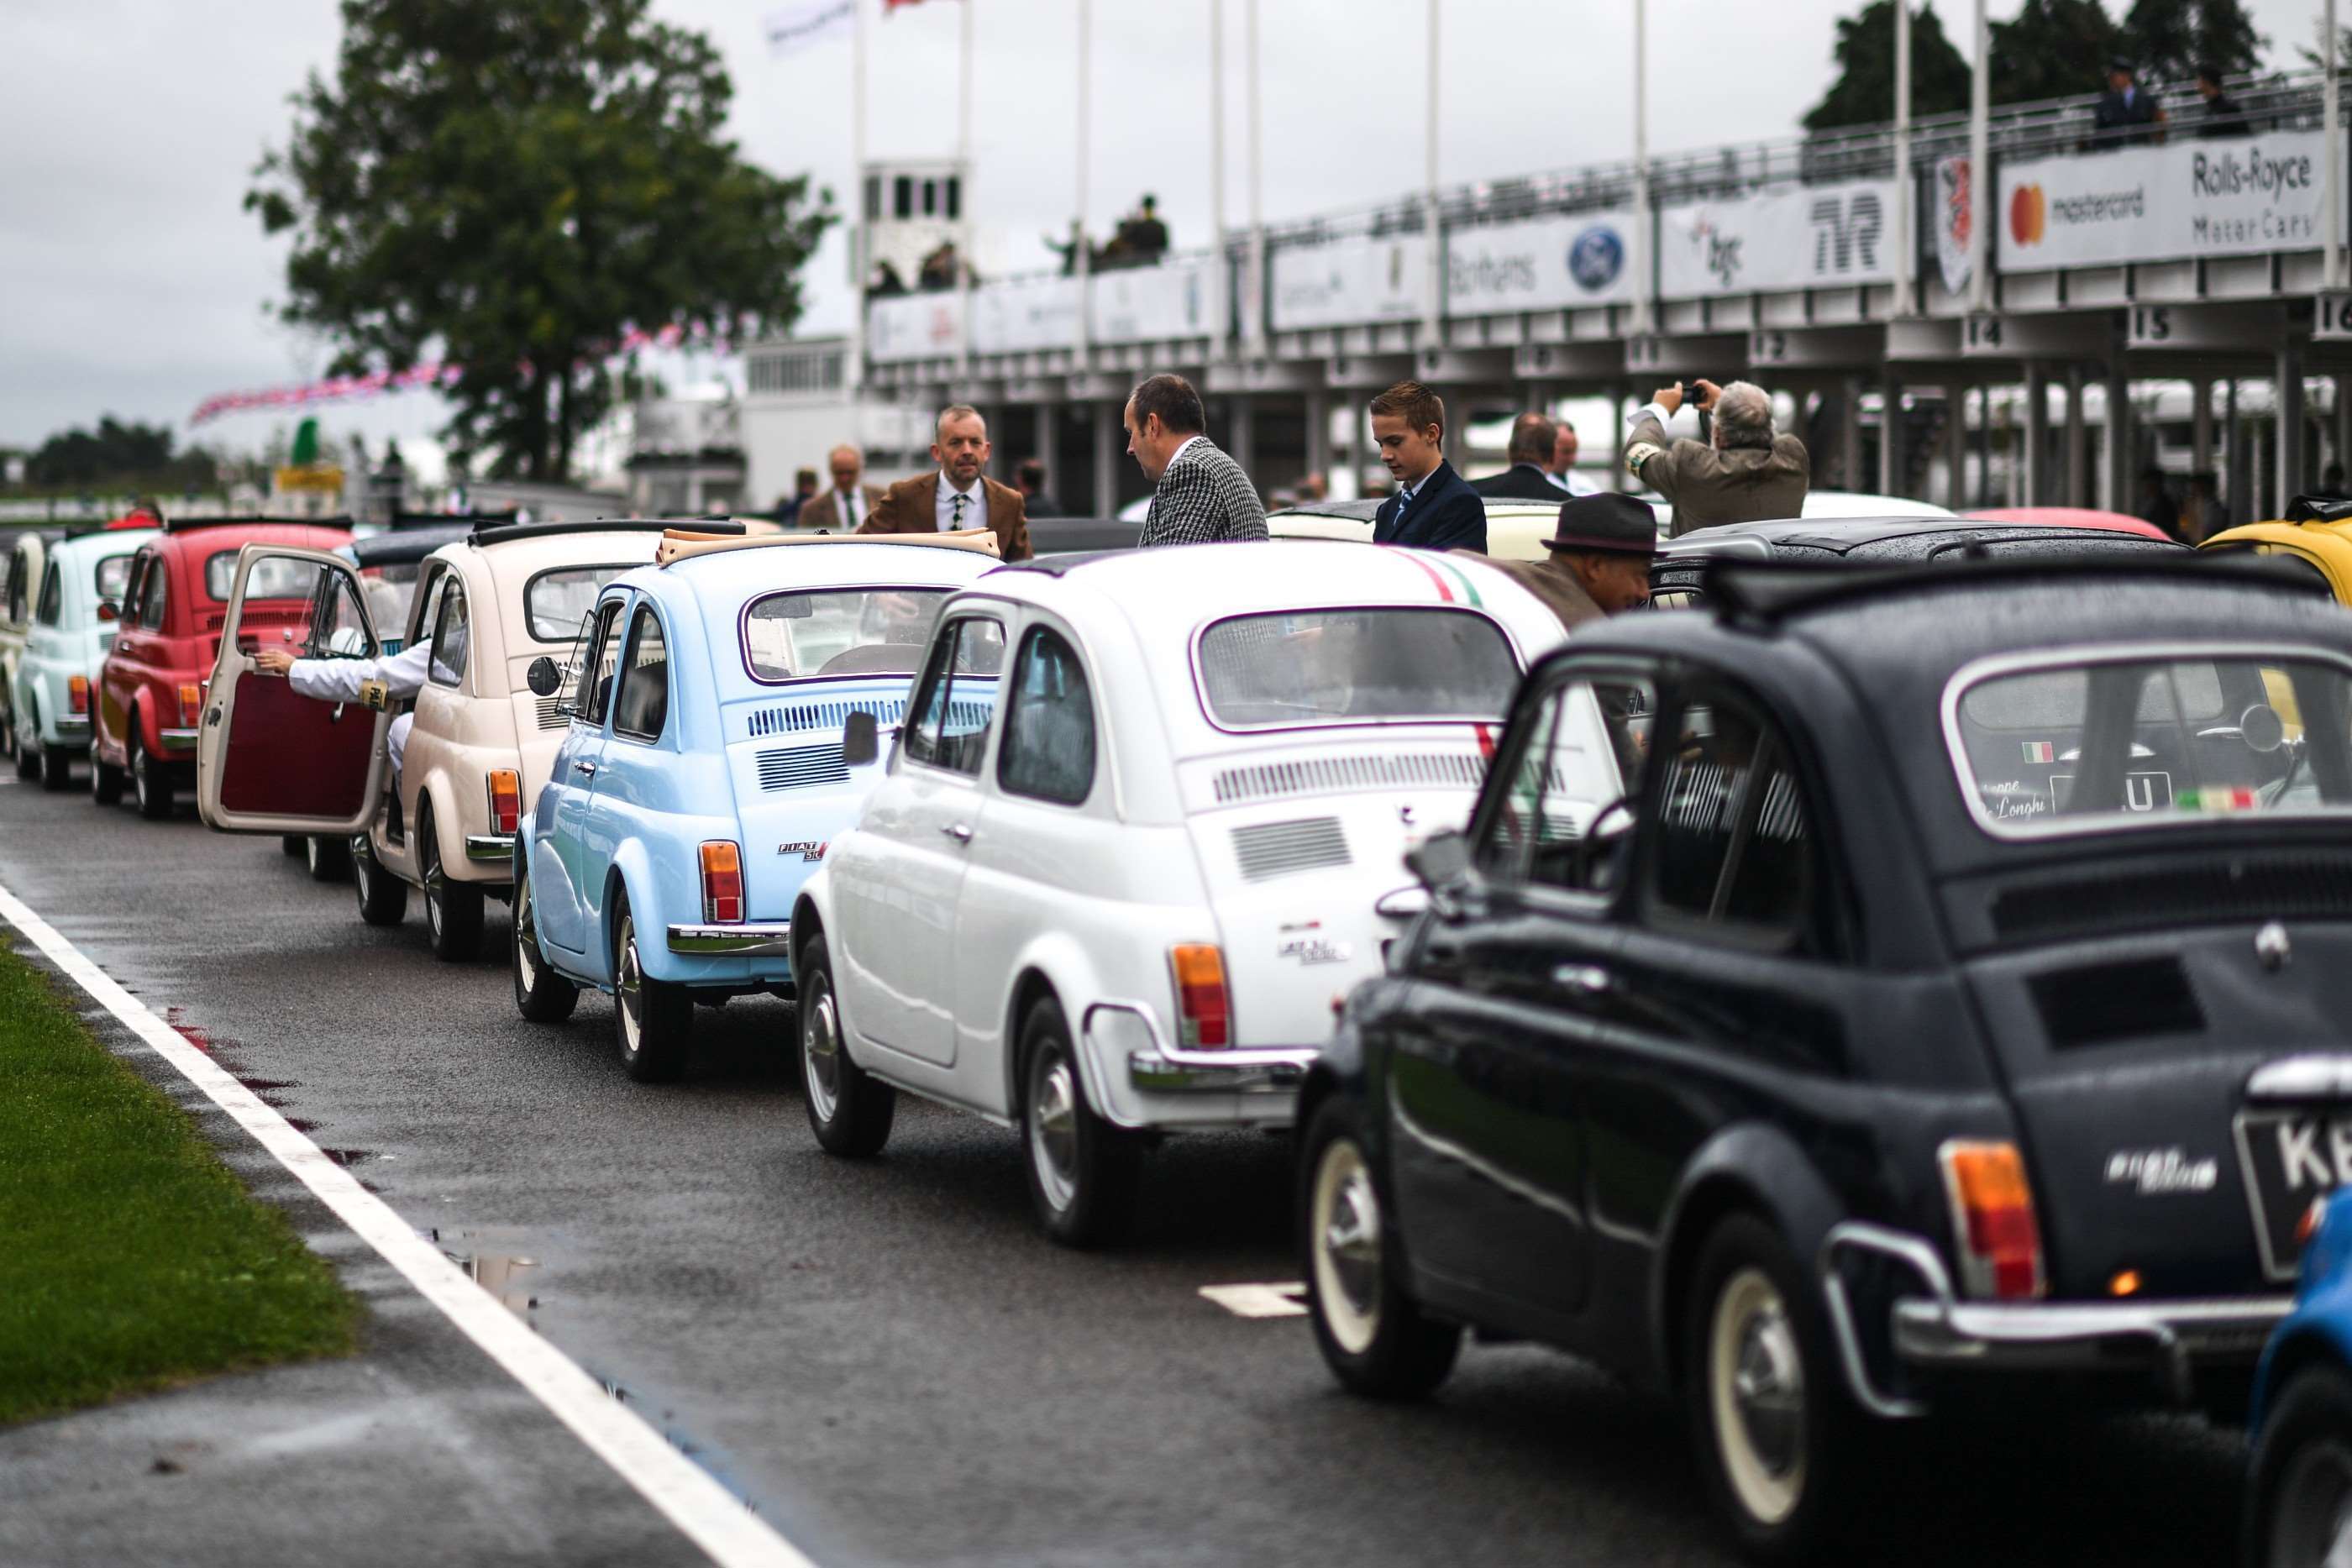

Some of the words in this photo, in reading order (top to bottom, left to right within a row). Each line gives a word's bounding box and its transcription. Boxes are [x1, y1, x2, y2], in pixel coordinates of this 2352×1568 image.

[2193, 146, 2311, 203] Rolls-Royce
[2052, 183, 2144, 225] mastercard
[2193, 214, 2256, 244] Motor
[1969, 318, 2001, 346] 14
[2136, 307, 2170, 339] 15
[779, 842, 816, 852] FIAT
